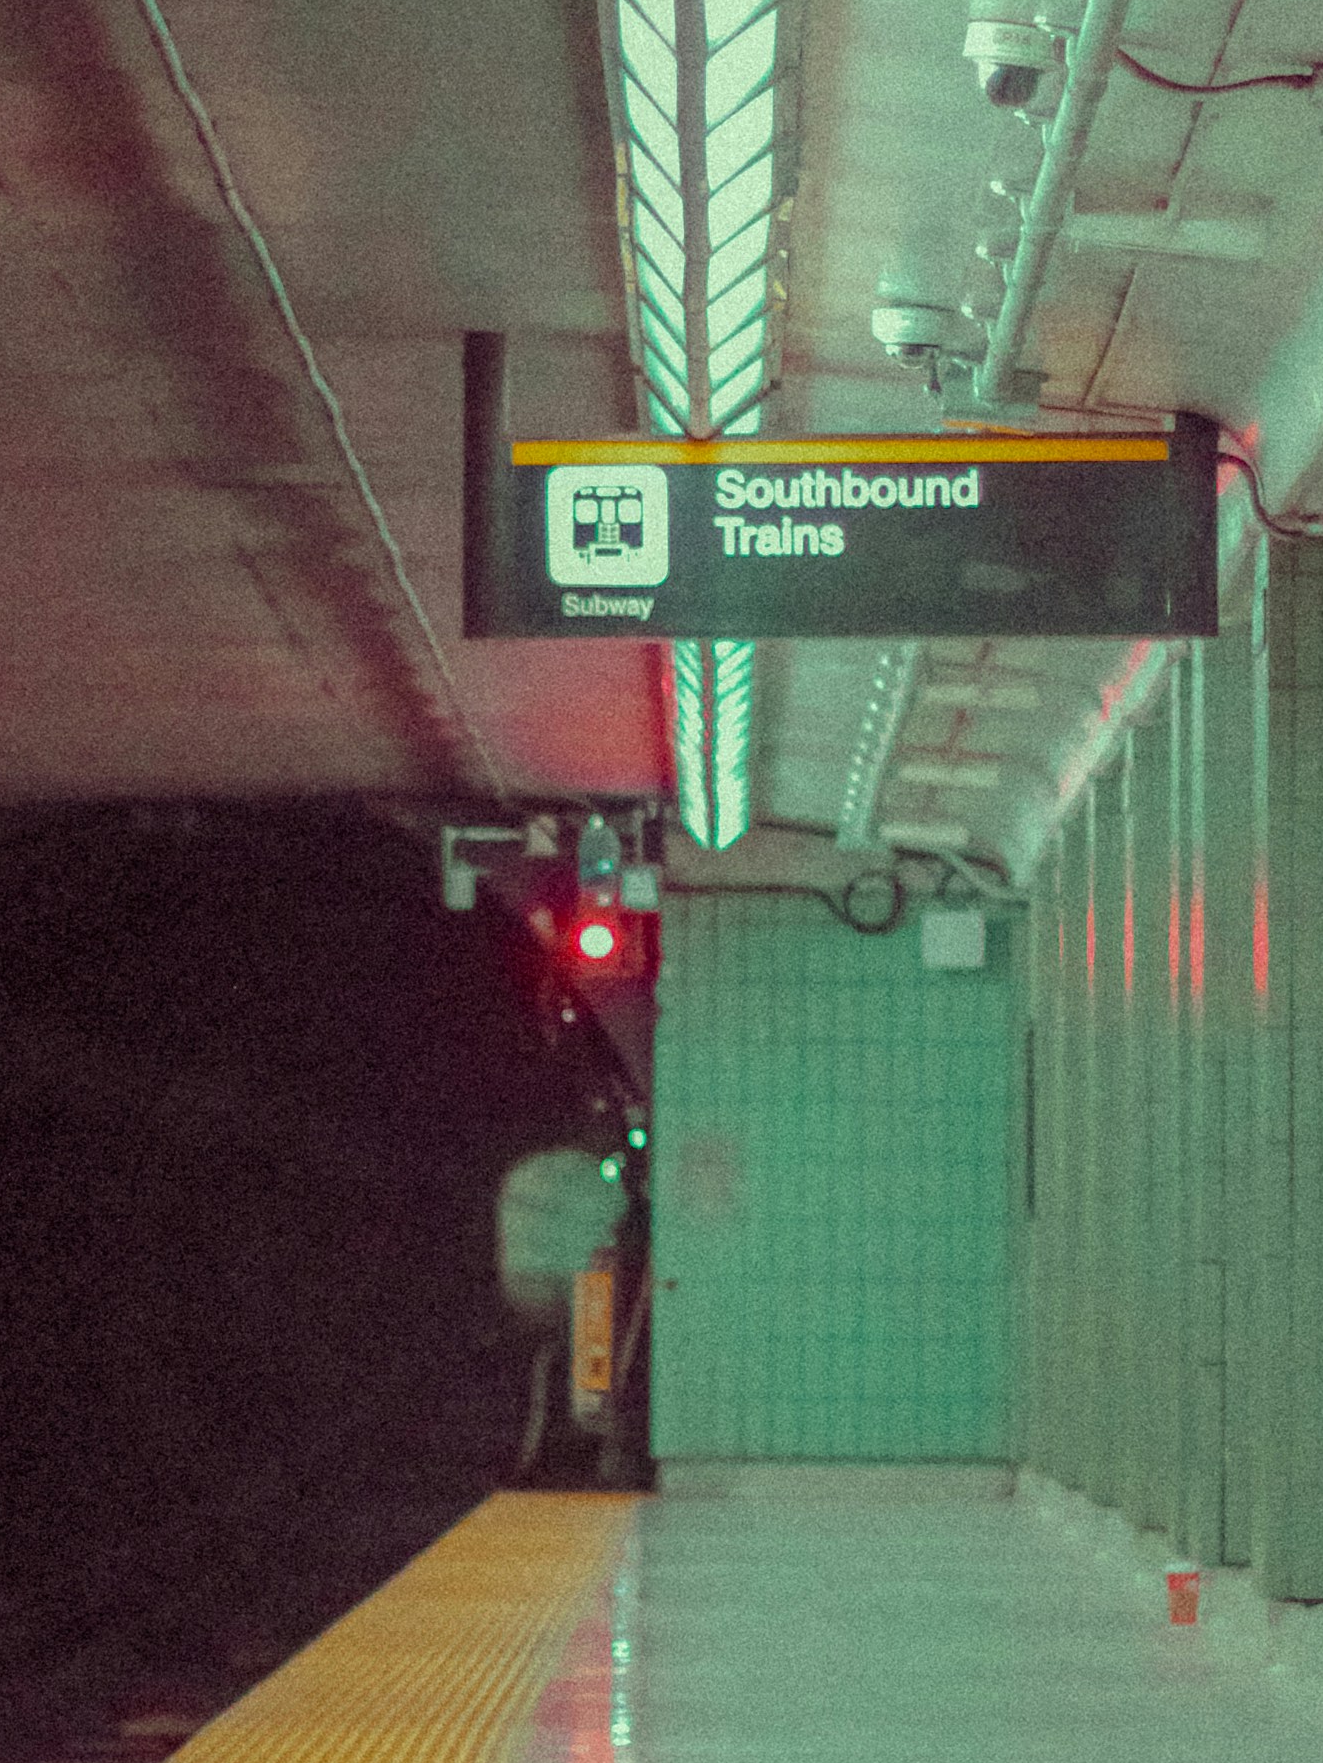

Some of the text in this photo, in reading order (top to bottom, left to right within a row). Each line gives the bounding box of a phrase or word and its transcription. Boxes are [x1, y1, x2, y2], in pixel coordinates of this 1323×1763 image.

[714, 468, 980, 510] Southbound
[713, 515, 846, 557] Trains
[561, 592, 656, 622] Subway
